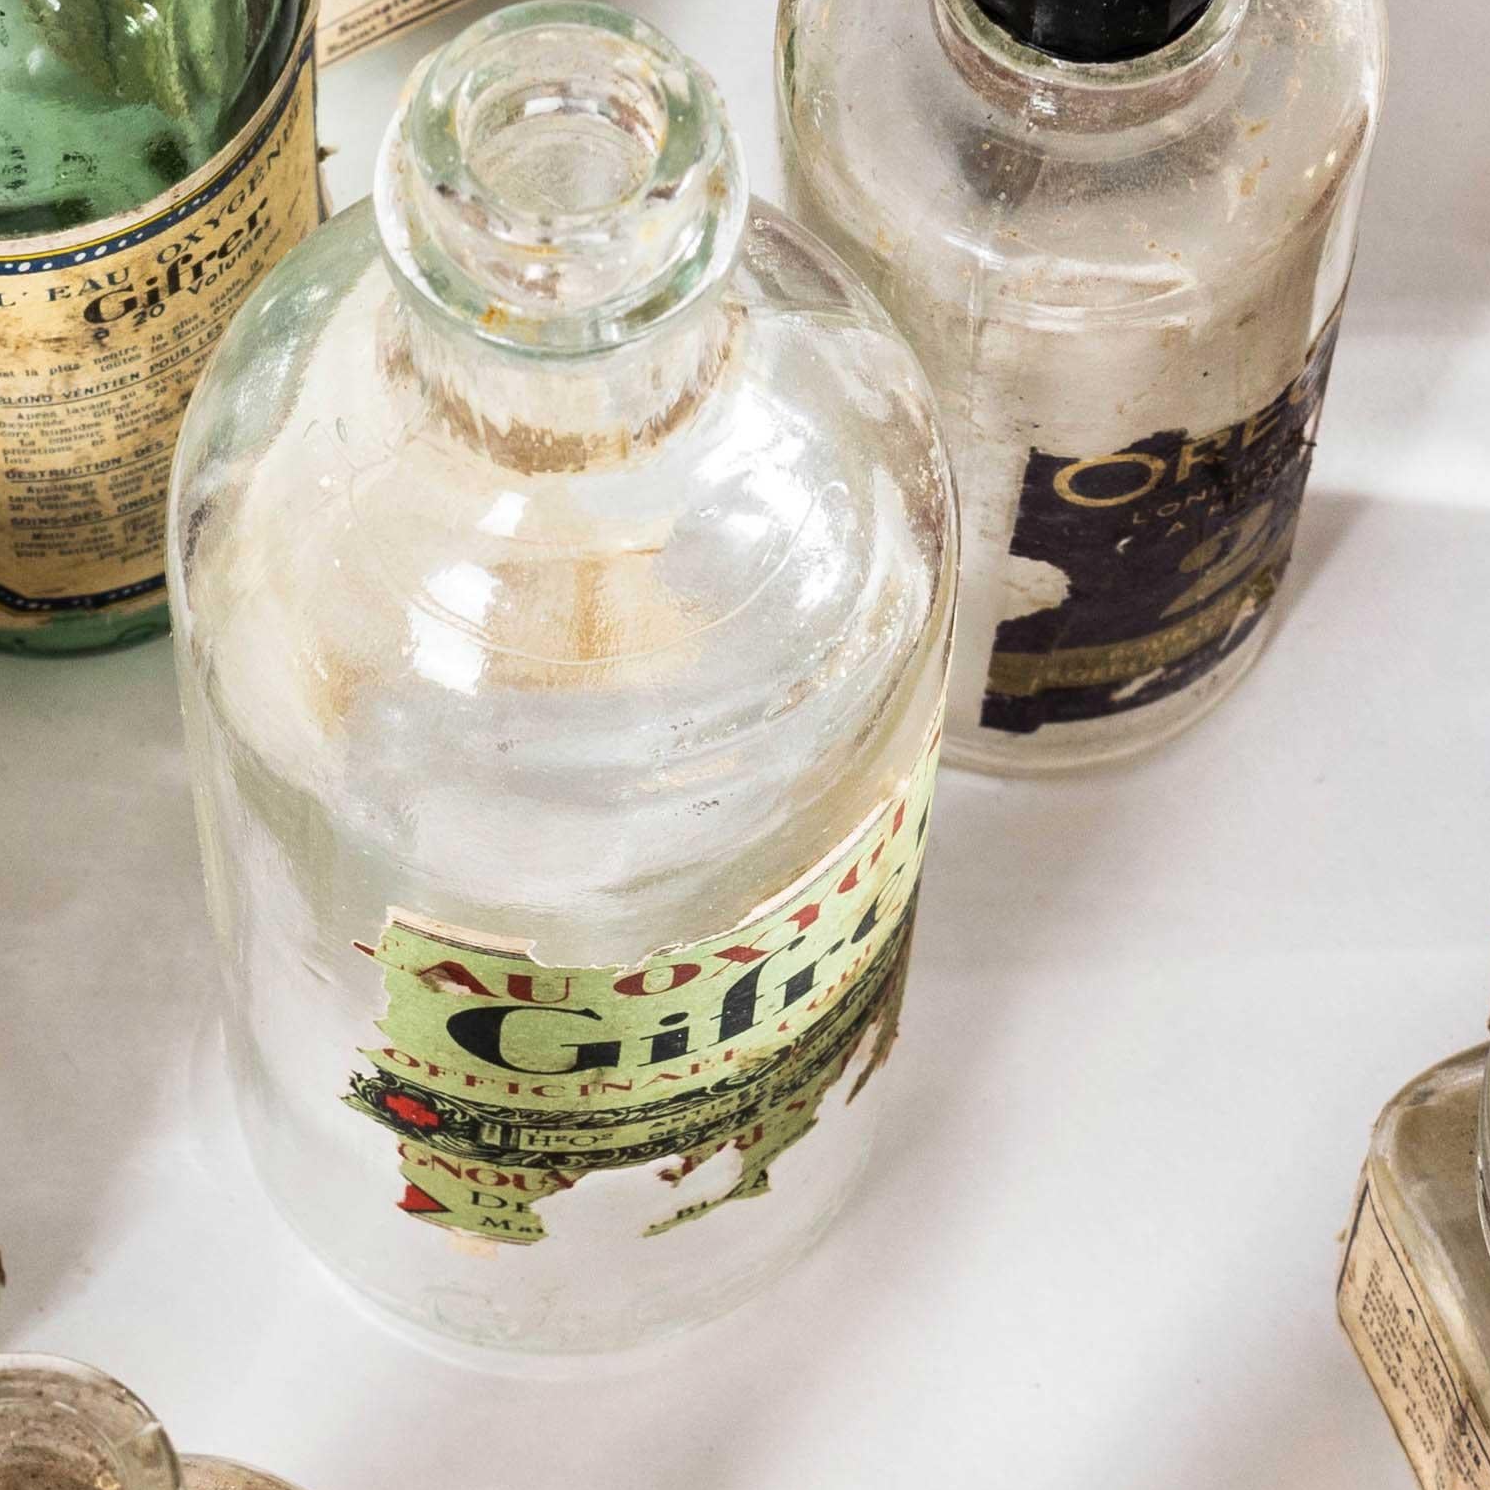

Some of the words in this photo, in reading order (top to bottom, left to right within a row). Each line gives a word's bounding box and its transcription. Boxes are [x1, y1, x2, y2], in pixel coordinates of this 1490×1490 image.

[83, 197, 268, 325] Gifrer
[133, 302, 165, 327] 20
[149, 346, 194, 374] POUR
